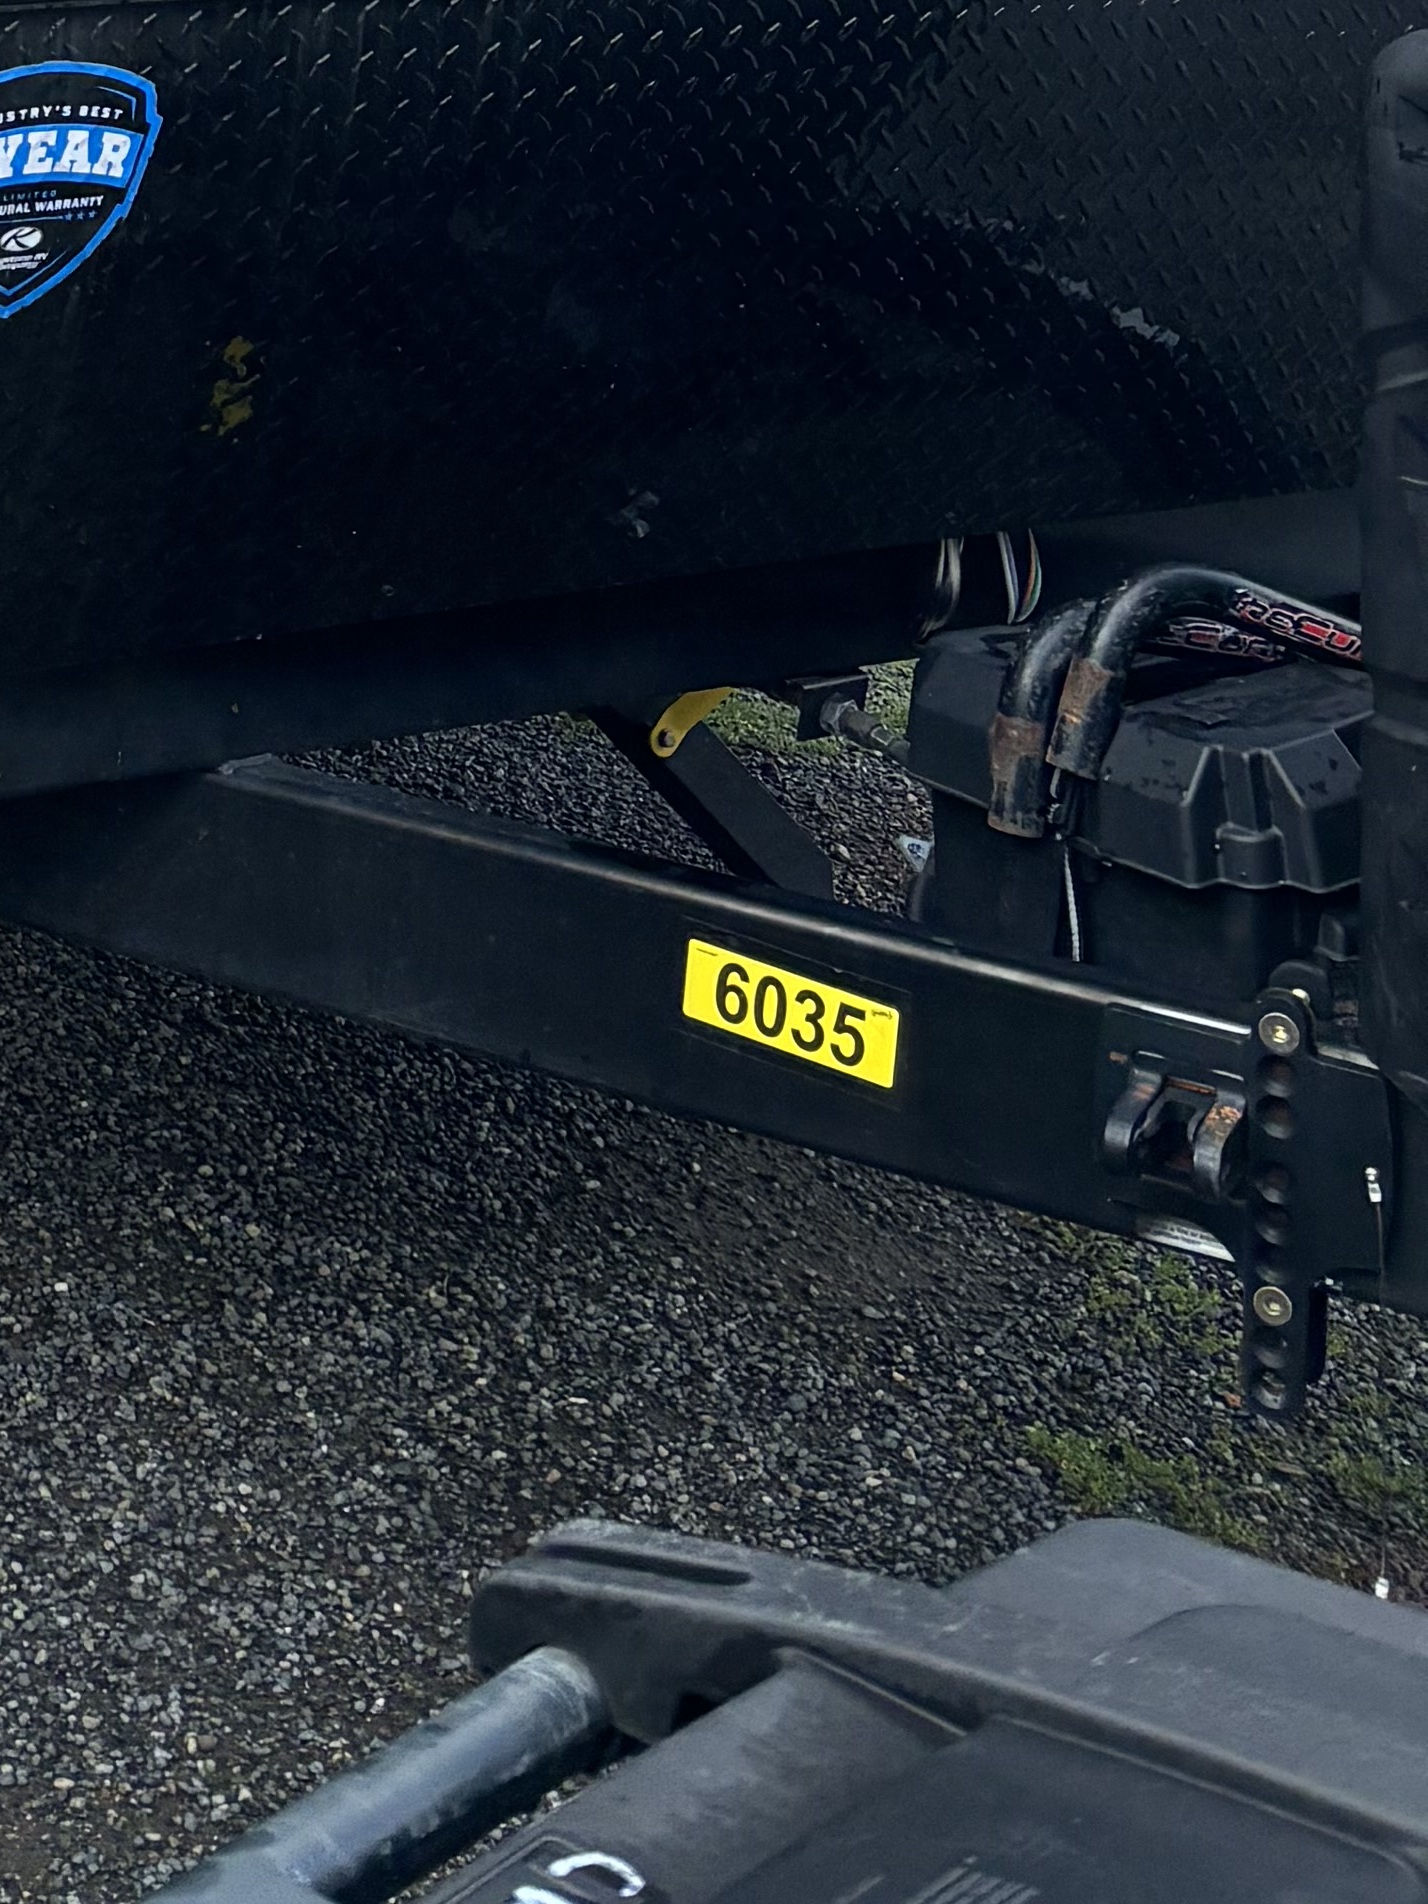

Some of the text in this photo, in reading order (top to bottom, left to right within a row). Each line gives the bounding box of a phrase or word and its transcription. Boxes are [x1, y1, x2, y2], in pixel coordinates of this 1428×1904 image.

[78, 105, 124, 120] BEST
[2, 189, 57, 202] LIMITED
[34, 195, 104, 212] WARRANTY
[715, 962, 866, 1067] 6035
